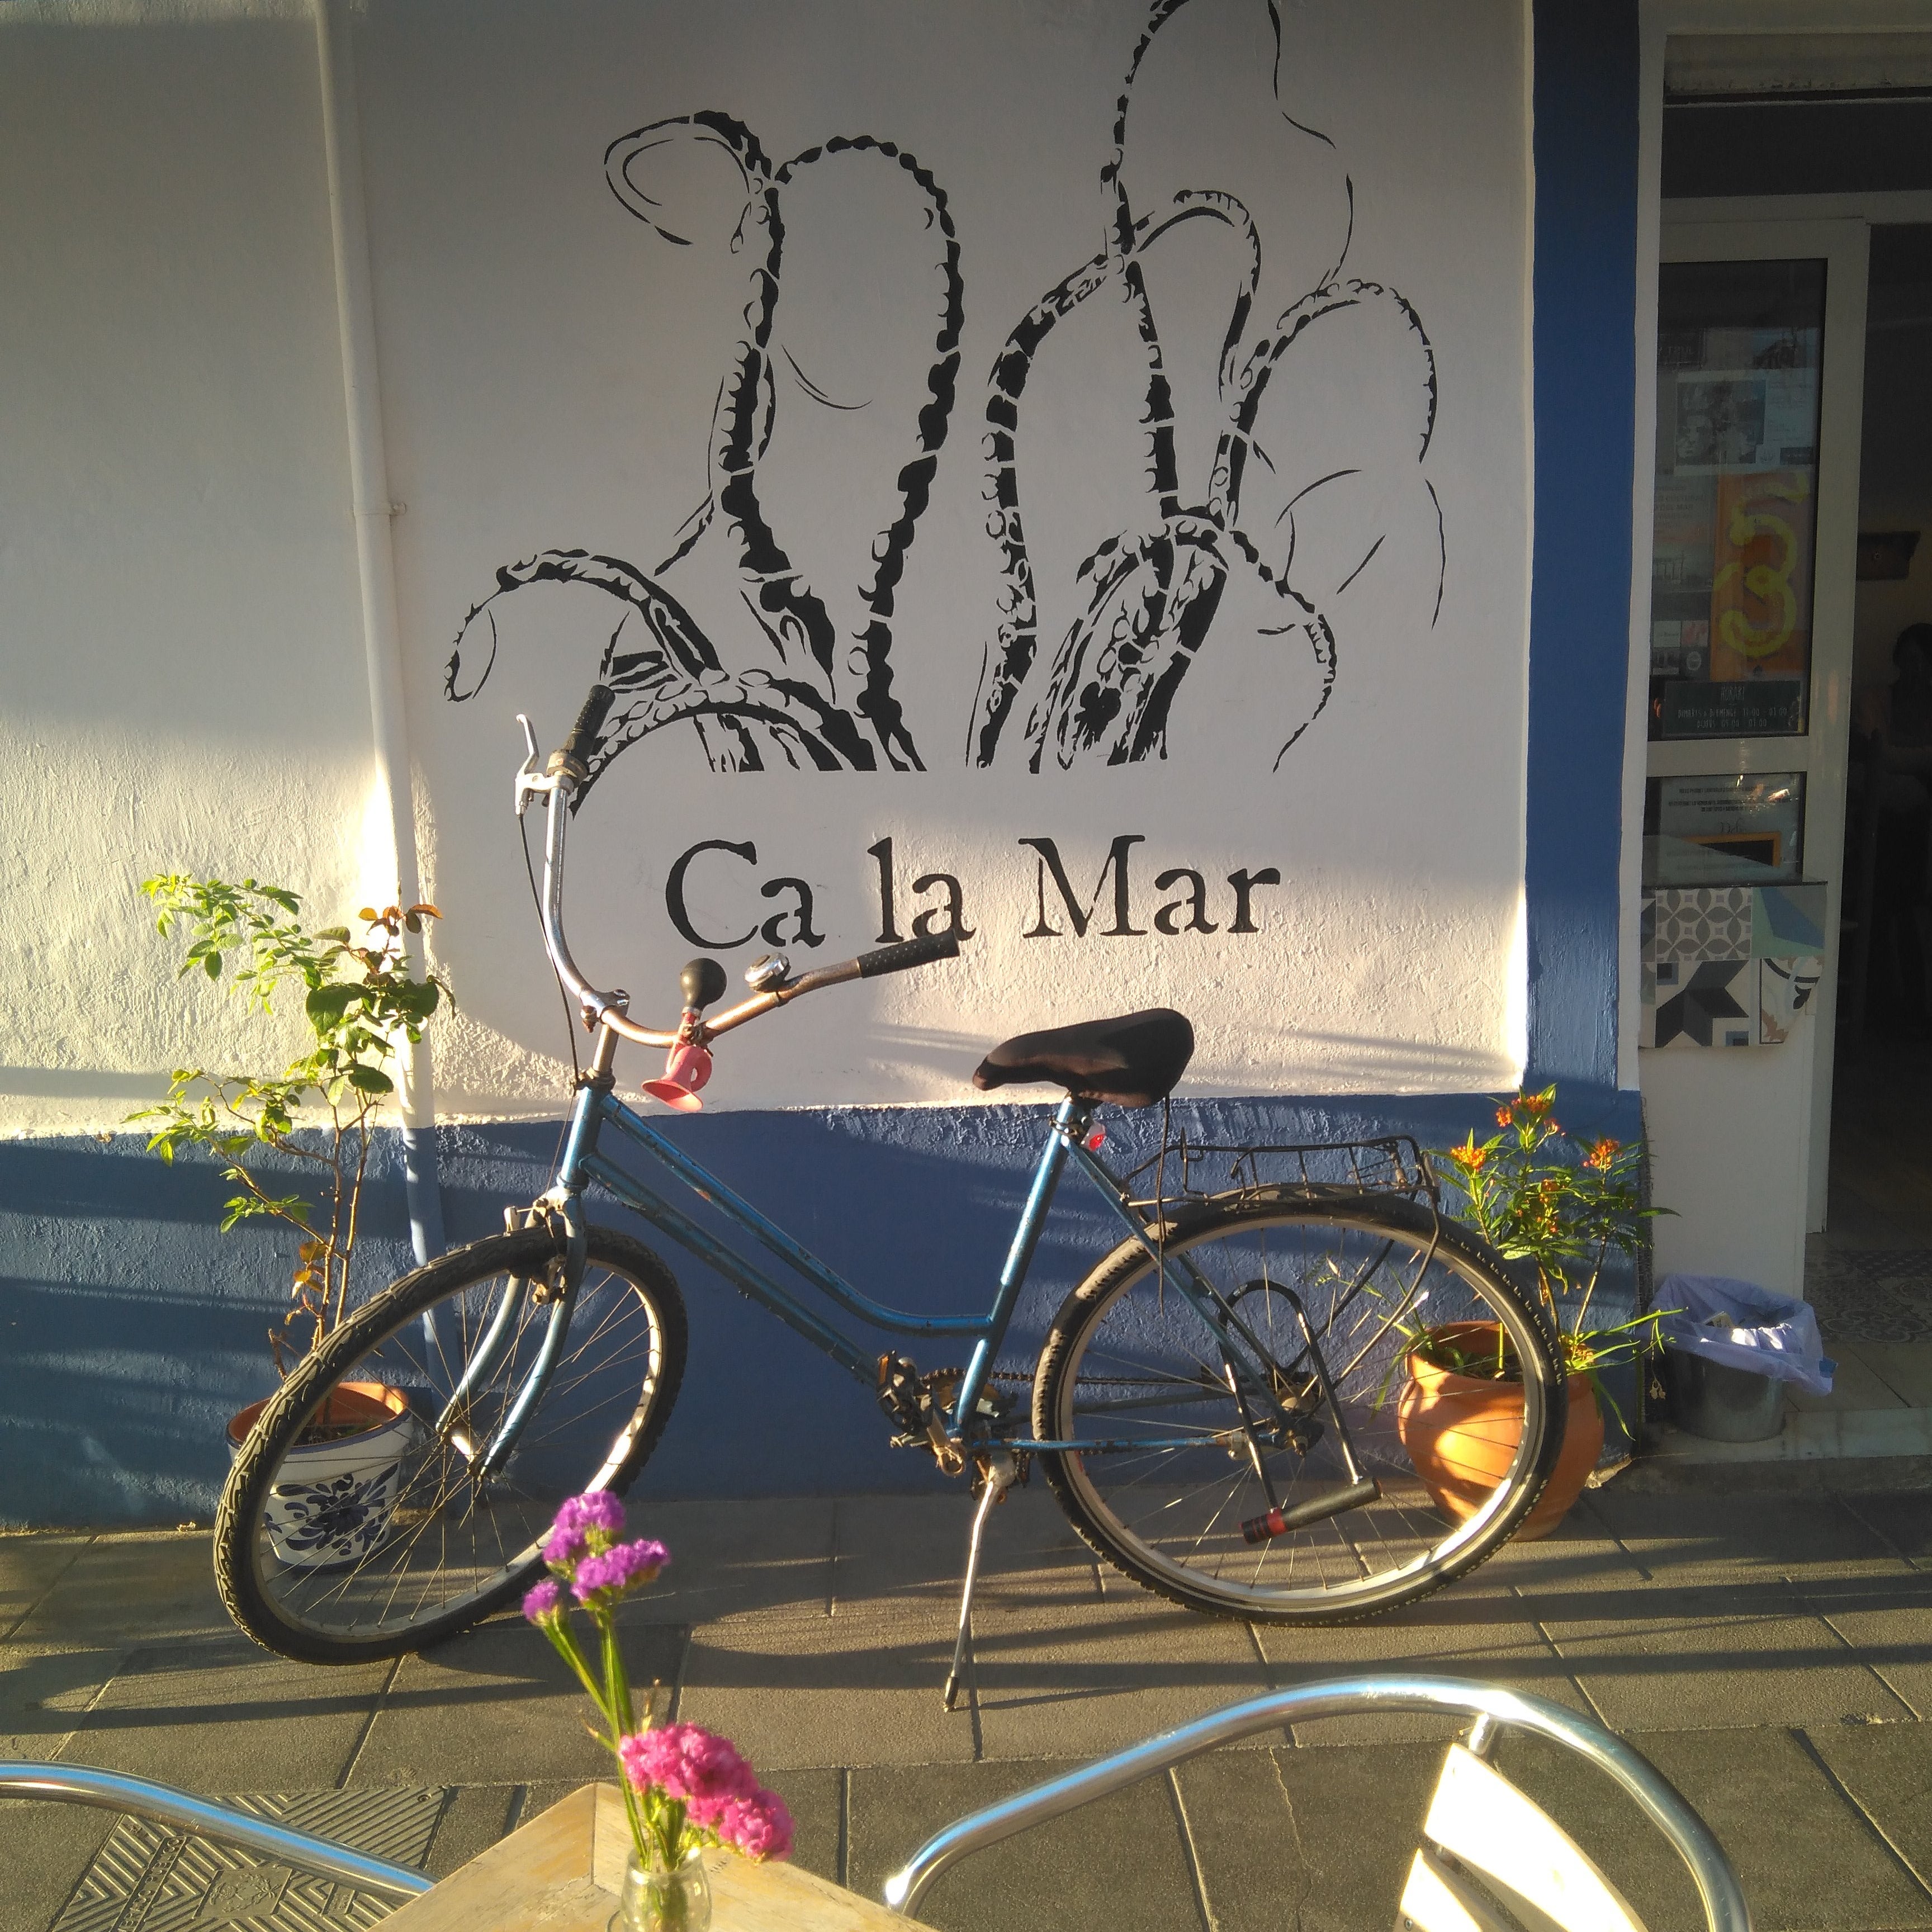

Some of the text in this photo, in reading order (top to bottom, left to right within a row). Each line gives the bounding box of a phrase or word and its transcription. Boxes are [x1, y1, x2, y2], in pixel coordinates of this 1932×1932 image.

[665, 835, 1280, 949] Ca la Mar
